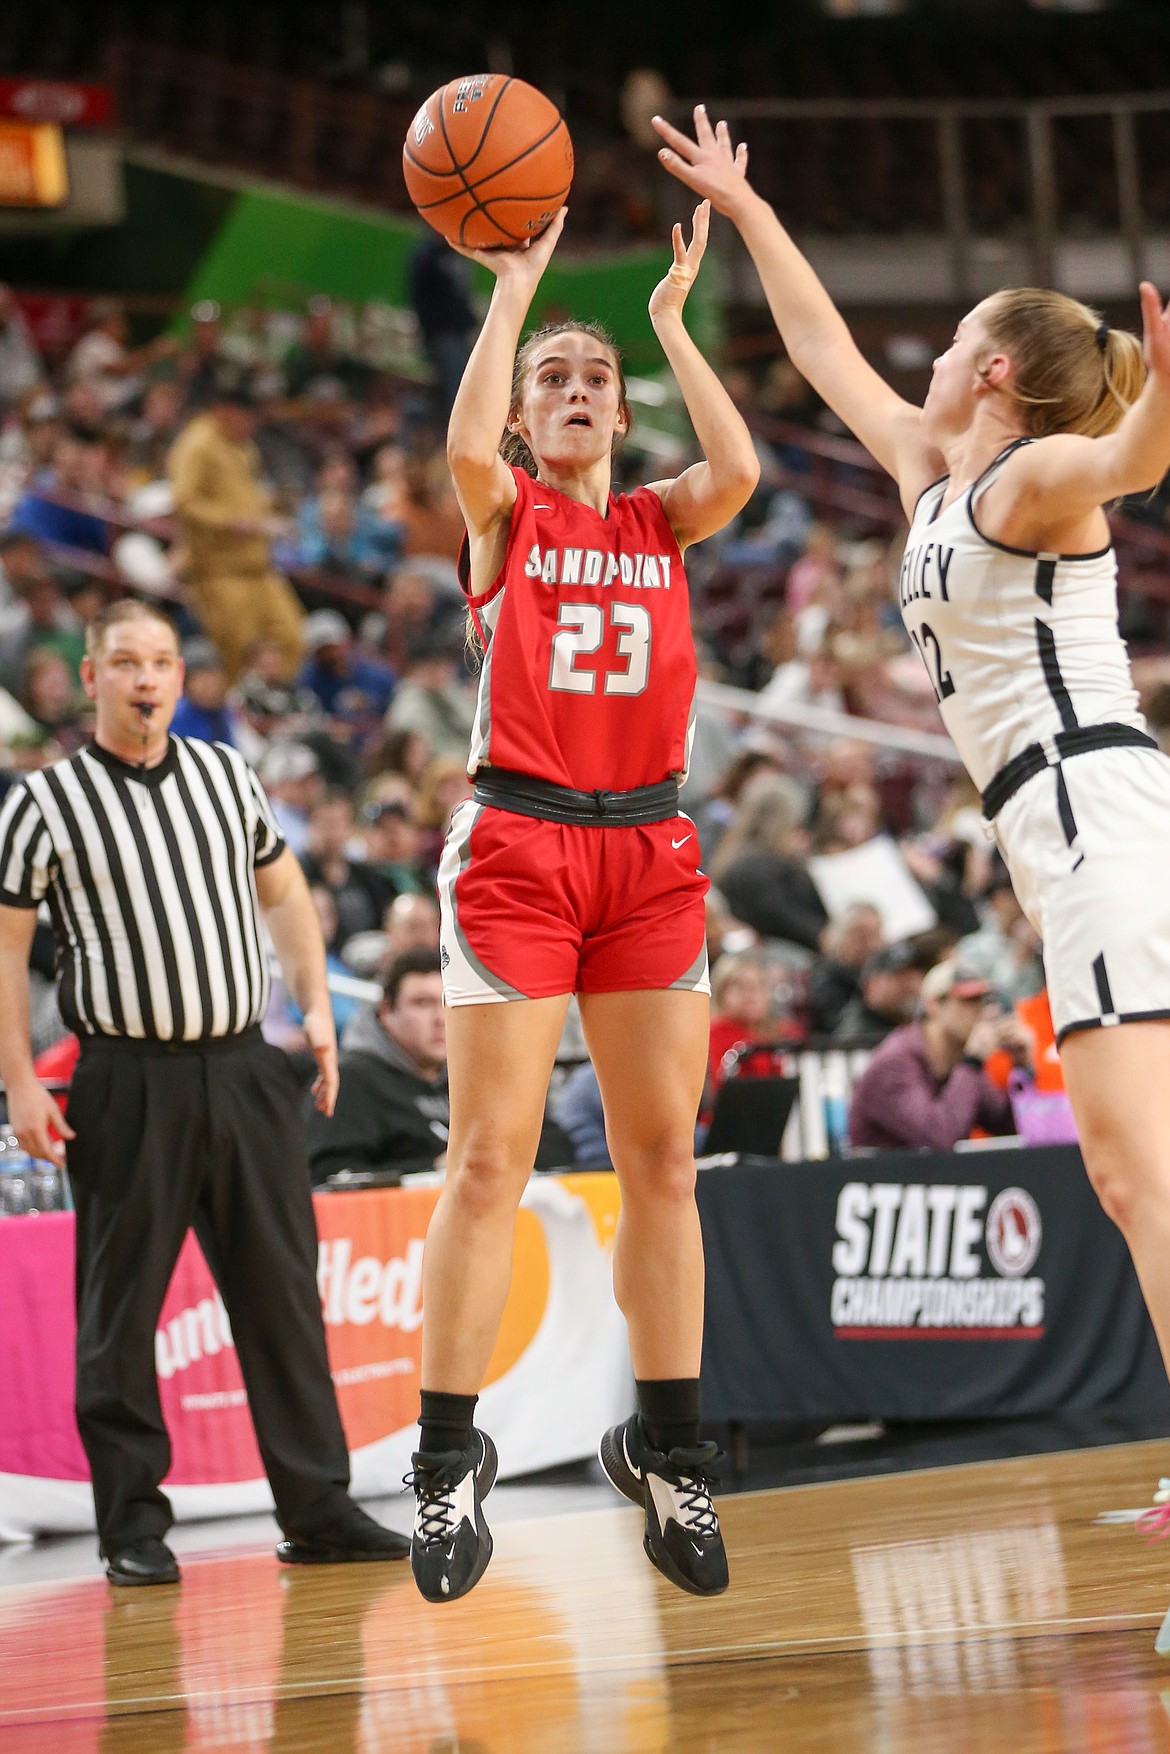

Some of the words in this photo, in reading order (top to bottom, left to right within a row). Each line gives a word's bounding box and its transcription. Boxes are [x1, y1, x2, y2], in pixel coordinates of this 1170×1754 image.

[524, 543, 671, 590] SANDPOINT
[547, 600, 651, 696] 23
[911, 621, 956, 704] 2
[832, 1182, 988, 1278] STATE
[831, 1276, 1046, 1329] CHAMPIONSHIPS
